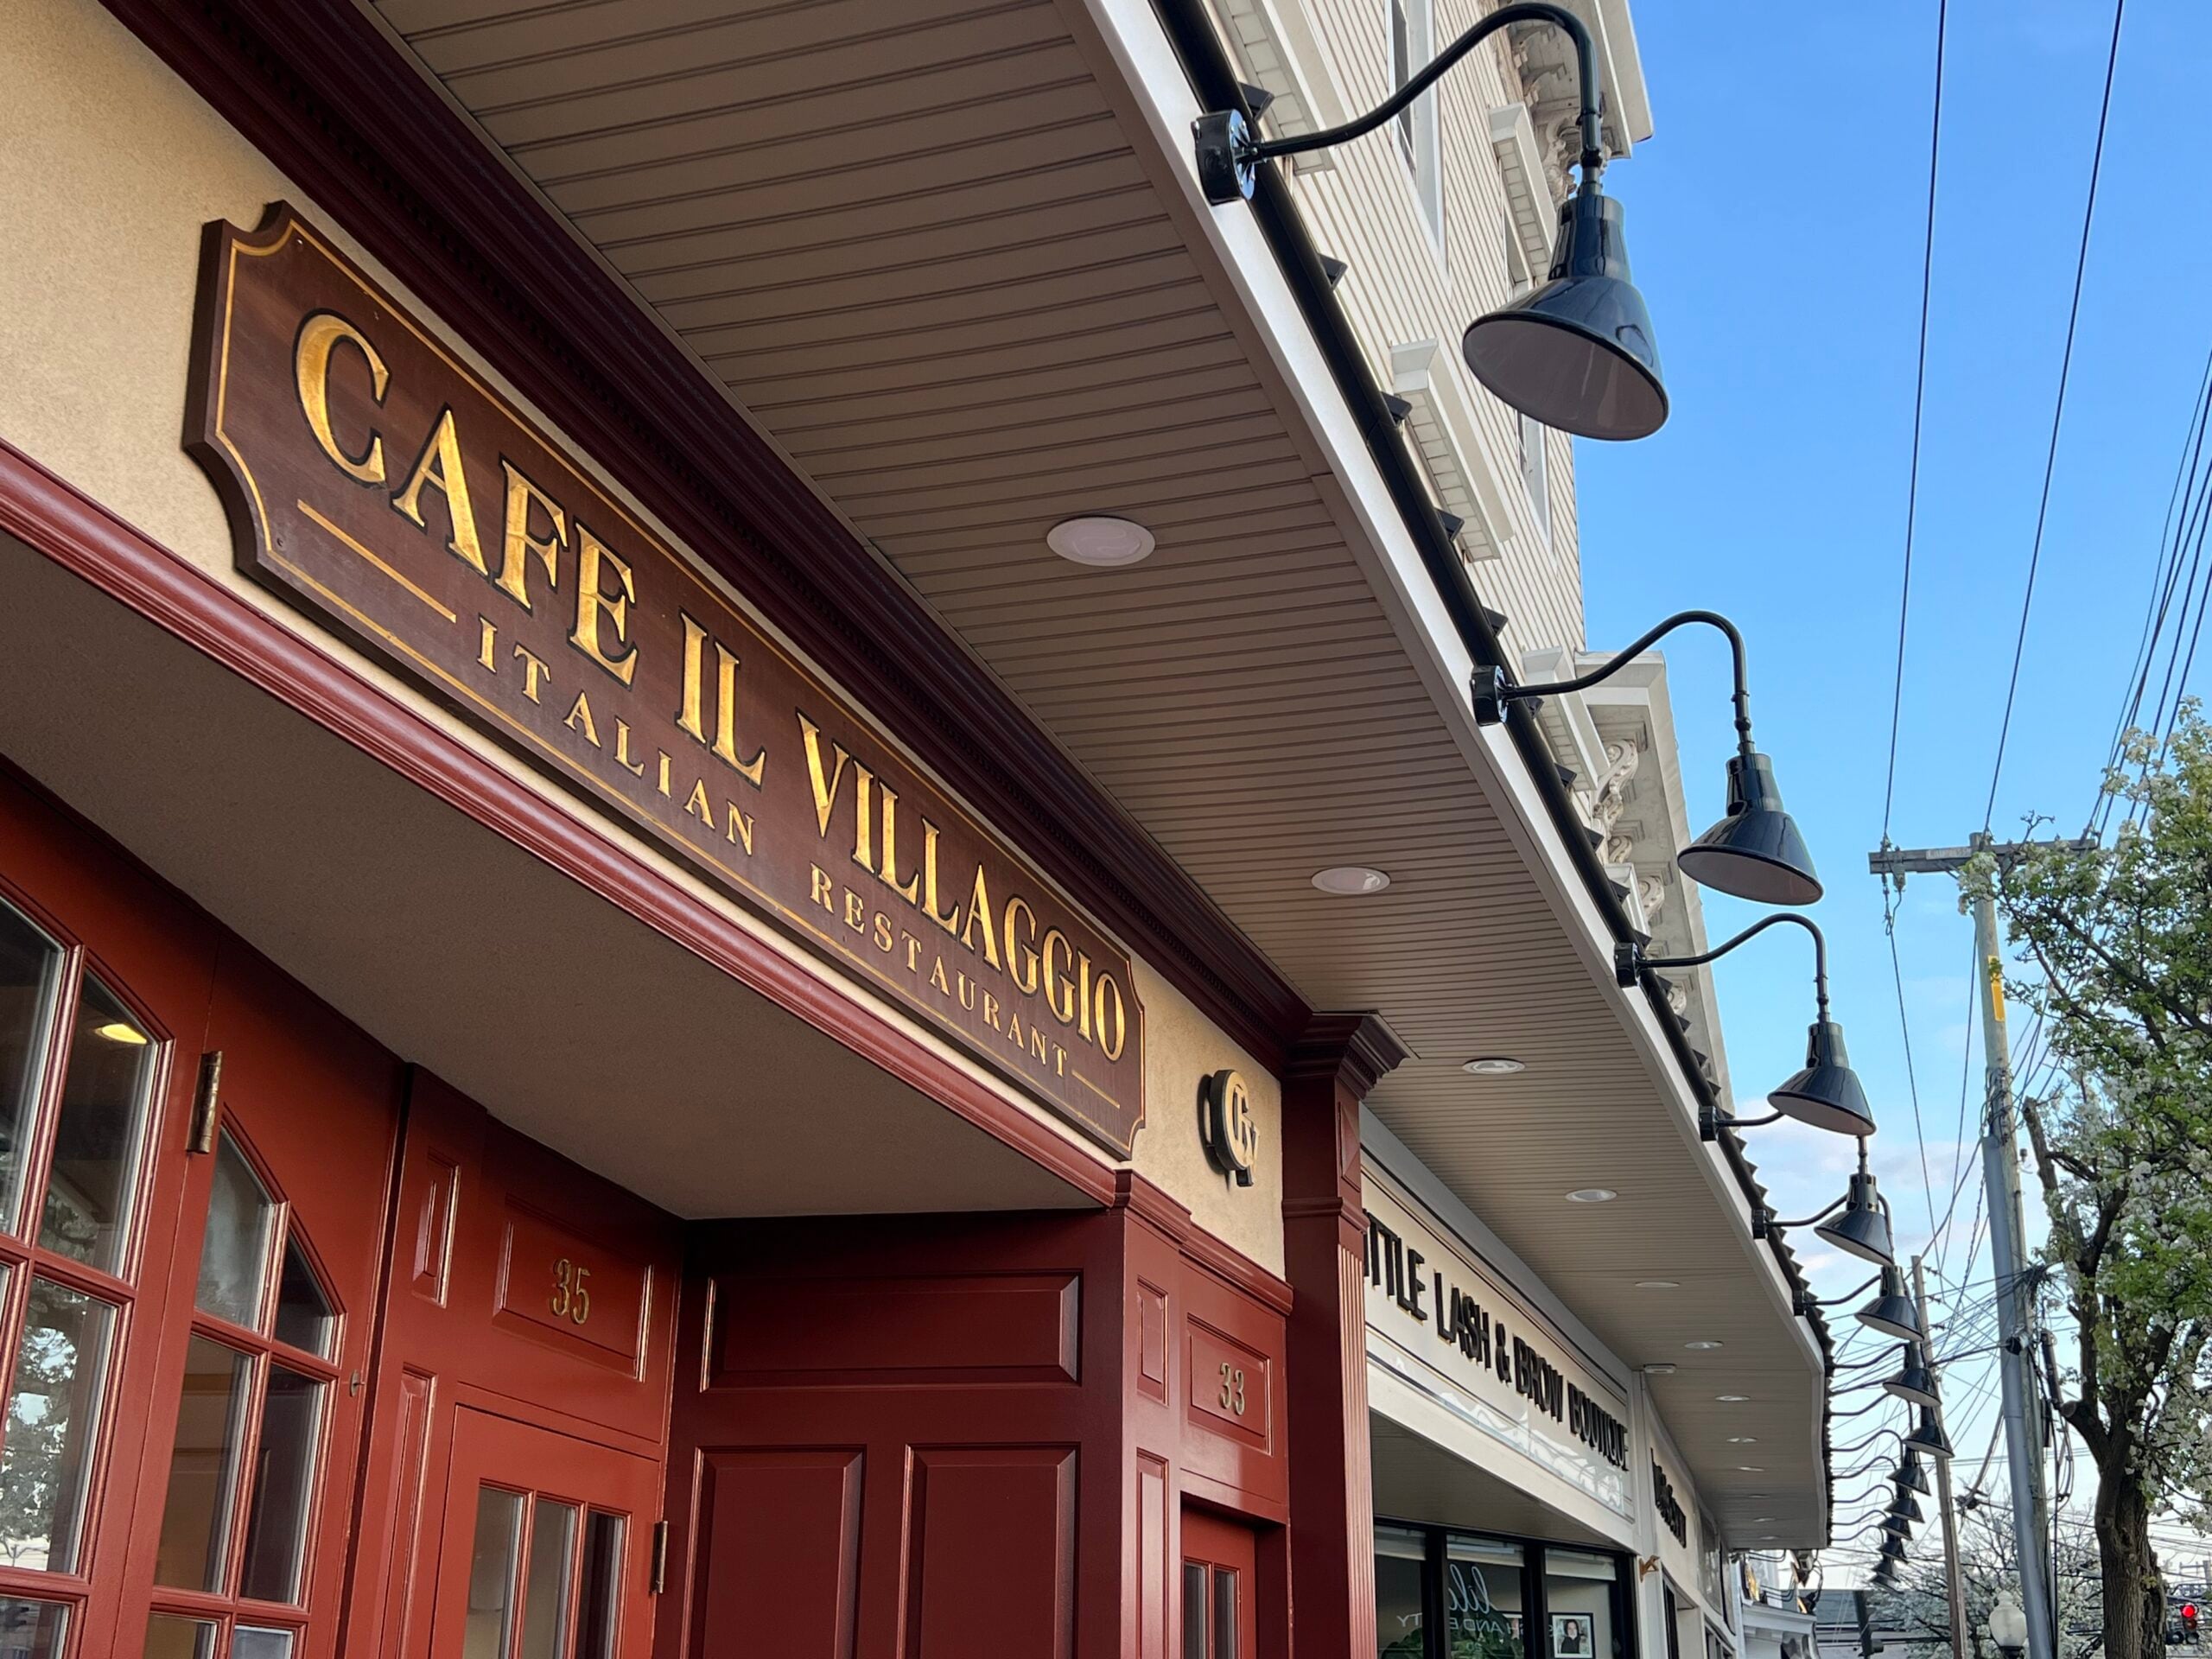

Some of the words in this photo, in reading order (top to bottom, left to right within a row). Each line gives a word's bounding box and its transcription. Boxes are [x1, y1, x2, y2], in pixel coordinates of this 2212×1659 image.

[294, 309, 639, 688] CAFE
[676, 609, 766, 789] IL
[797, 709, 1126, 1064] VILLAGGIO
[476, 613, 755, 856] ITALIAN
[809, 862, 1069, 1077] RESTAURANT
[550, 1259, 591, 1325] 35
[1219, 1363, 1245, 1415] 33
[1434, 1272, 1491, 1370] LASH
[1495, 1323, 1512, 1383] &
[1514, 1336, 1564, 1422] BROW
[1567, 1382, 1630, 1471] BOUTIQUE
